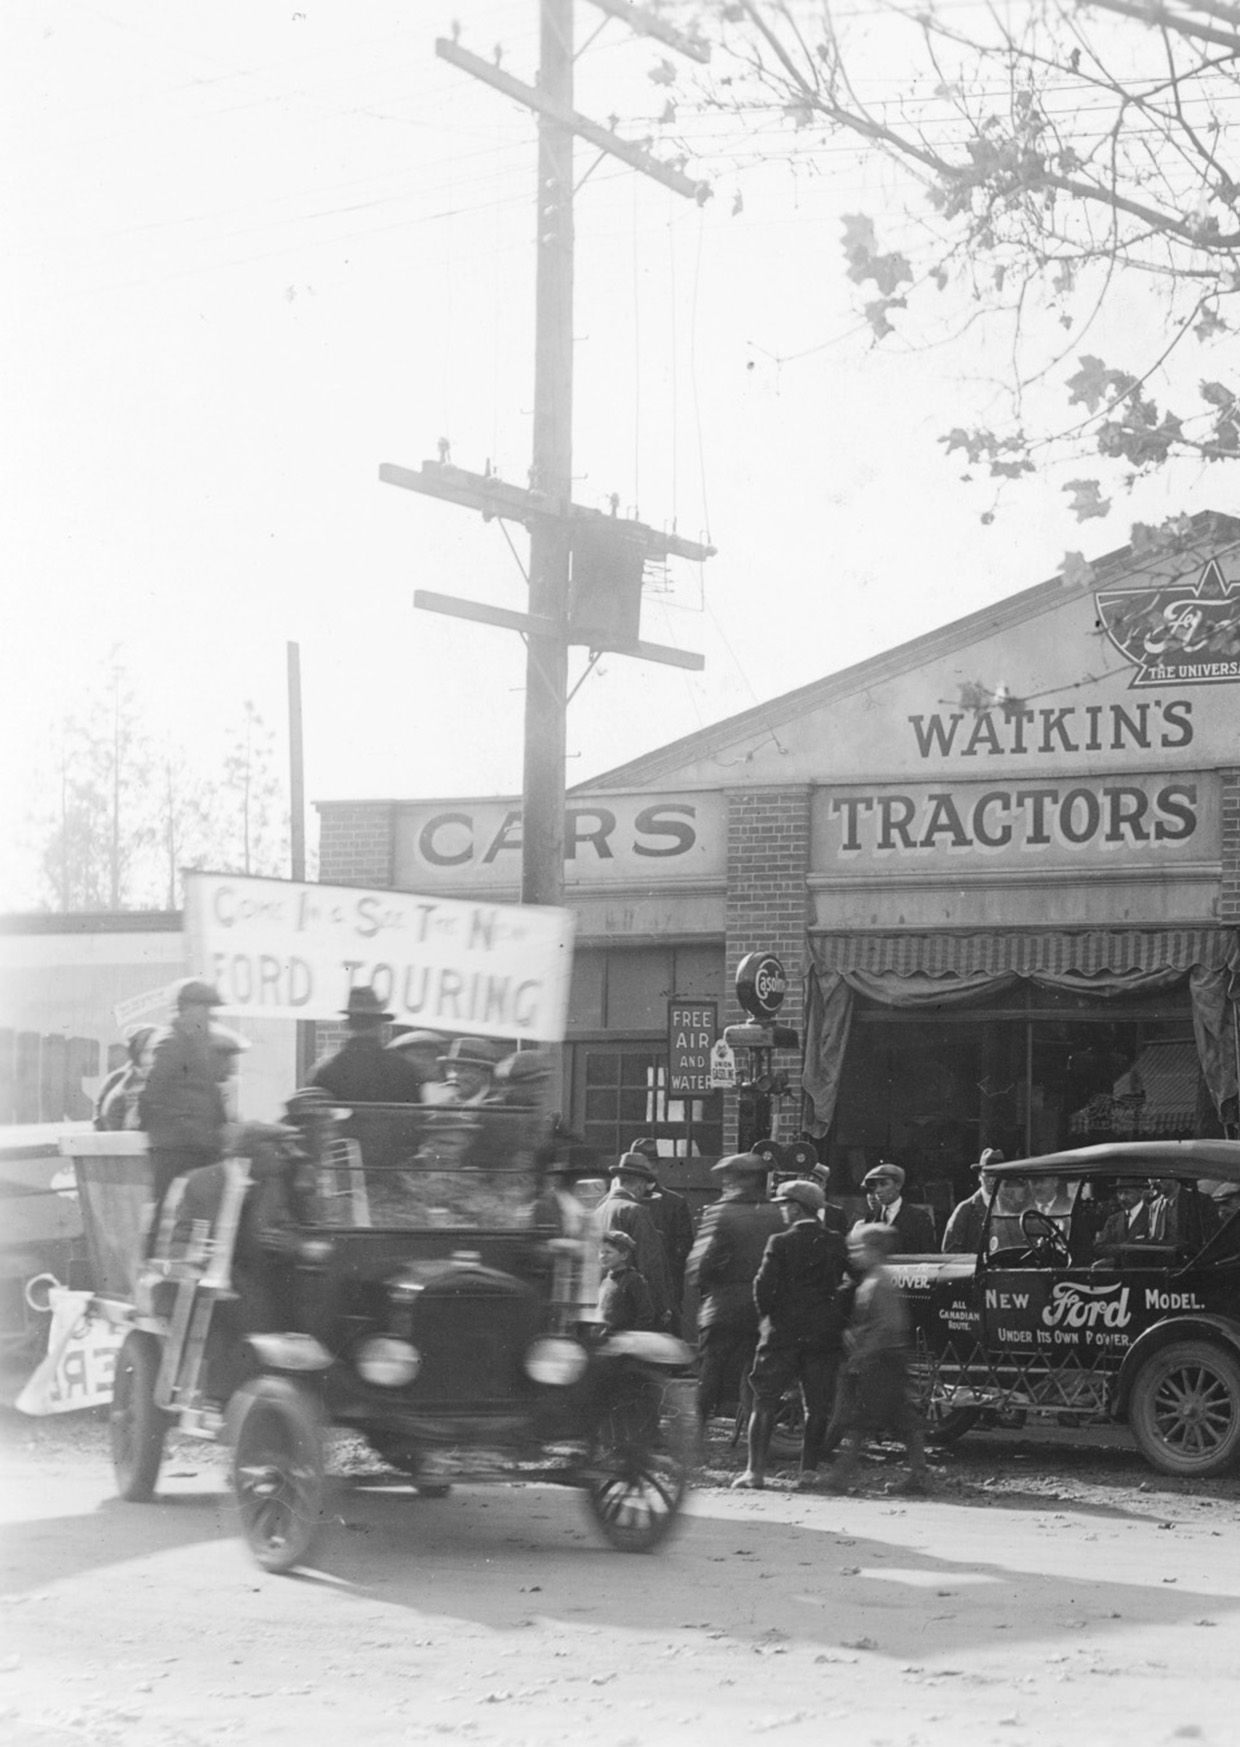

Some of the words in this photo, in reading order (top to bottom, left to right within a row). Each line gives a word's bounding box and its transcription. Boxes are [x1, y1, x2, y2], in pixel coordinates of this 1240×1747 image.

[1149, 665, 1177, 680] THE
[908, 699, 1194, 759] WATKIN'S
[831, 783, 1199, 852] TRACTORS
[418, 803, 697, 867] CARS
[213, 952, 313, 1007] FORD
[342, 960, 541, 1028] TOURING
[673, 1011, 712, 1028] FREE
[675, 1032, 710, 1049] AIR
[680, 1055, 706, 1068] AND
[671, 1075, 713, 1090] WATER
[952, 1300, 968, 1310] ALL
[986, 1288, 1030, 1310] NEW
[1042, 1281, 1132, 1328] Ford
[1145, 1288, 1206, 1310] MODEL.
[939, 1309, 981, 1321] CANADIAN
[998, 1327, 1033, 1343] UNDER
[1037, 1329, 1052, 1344] ITS
[1054, 1330, 1080, 1345] OWN
